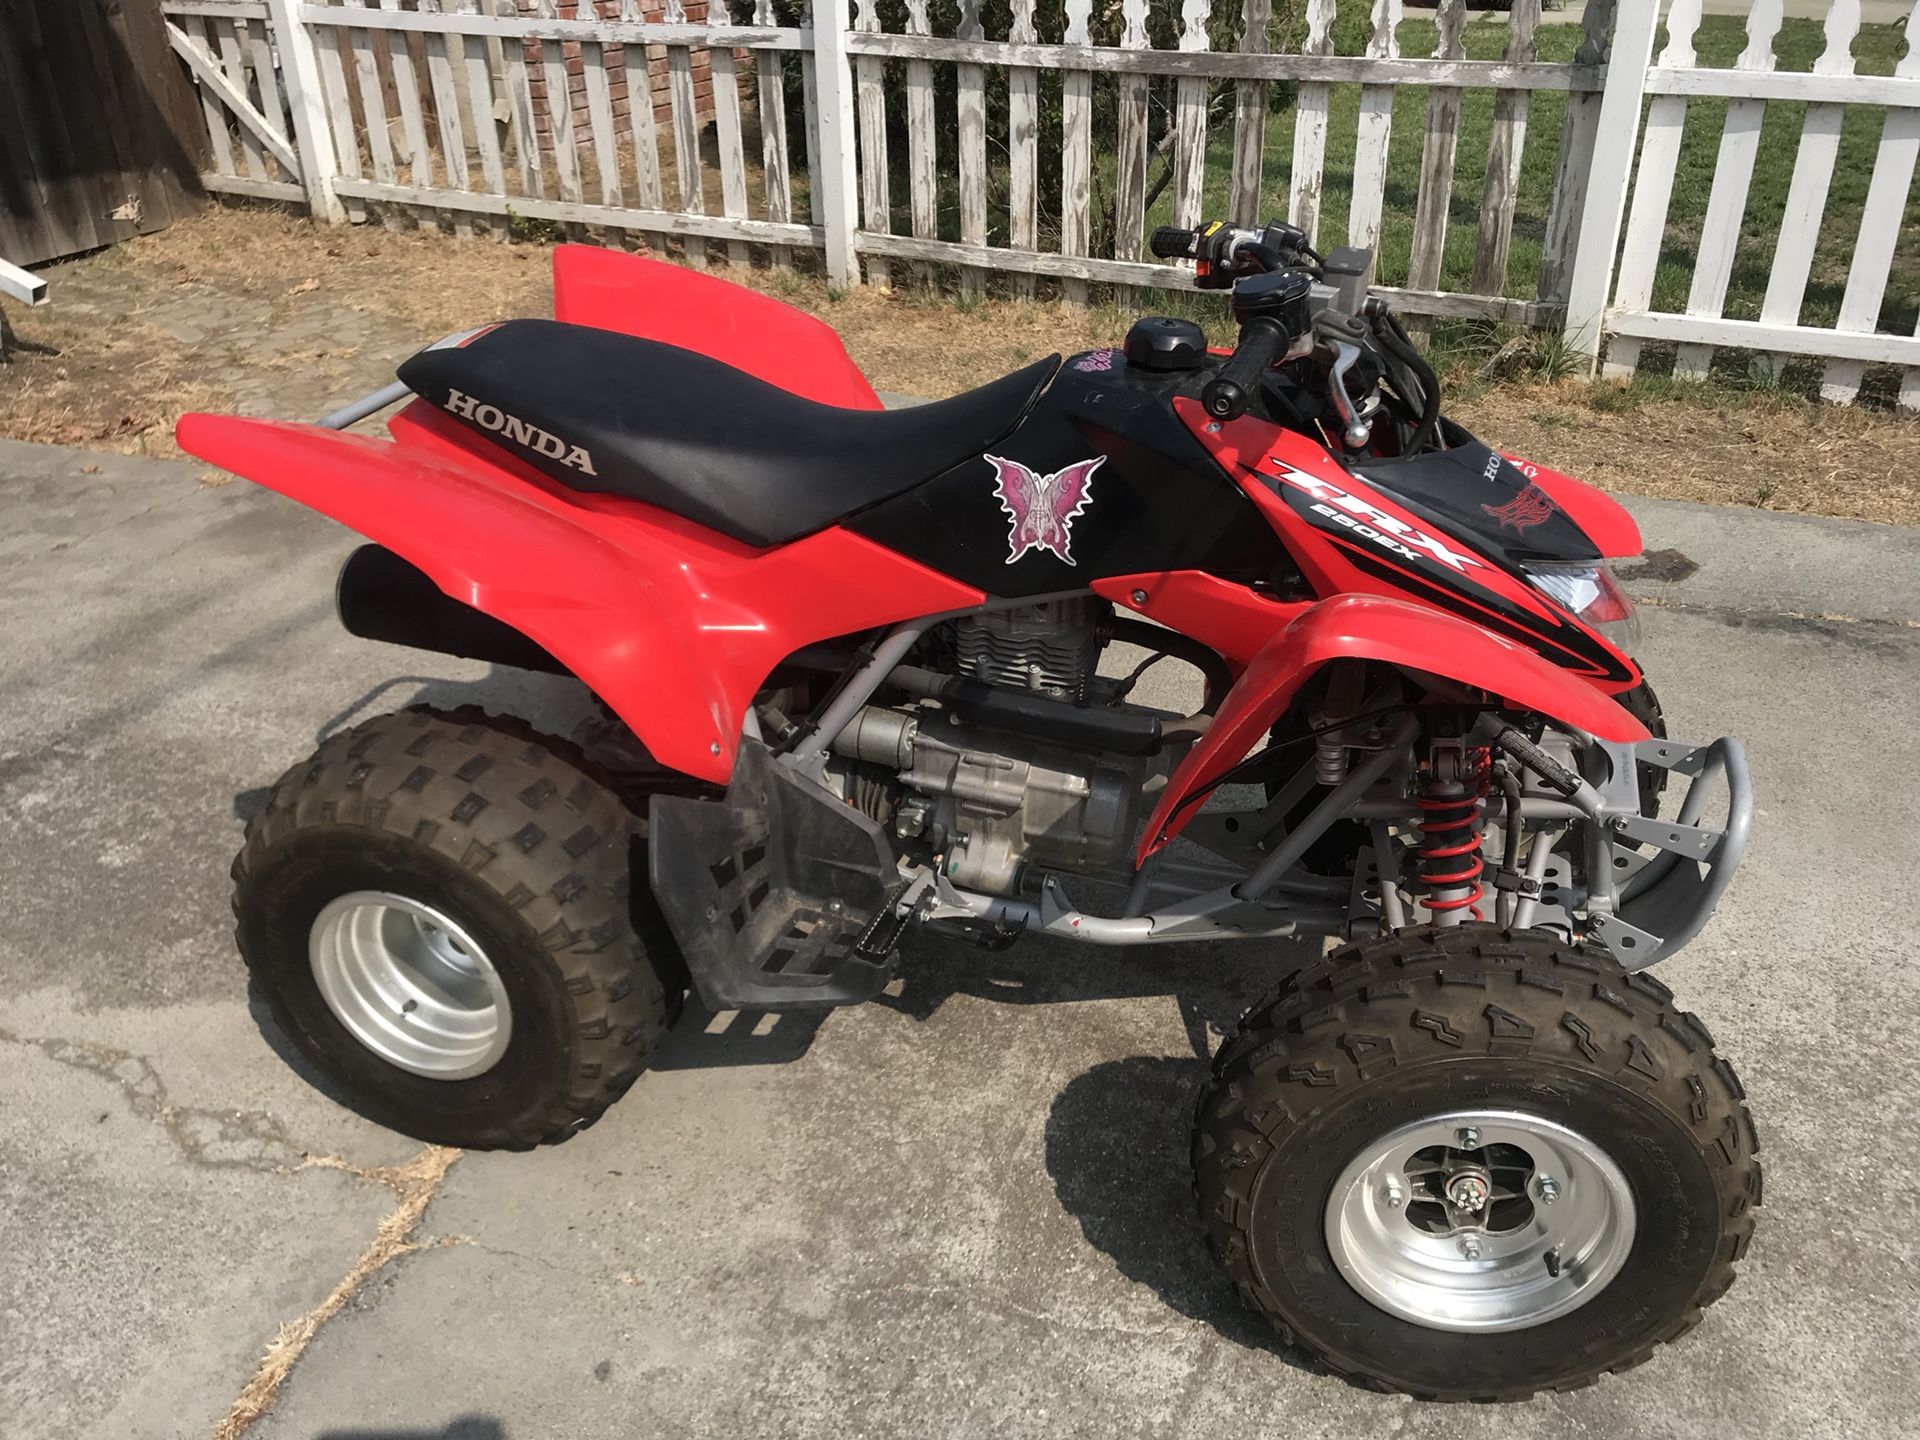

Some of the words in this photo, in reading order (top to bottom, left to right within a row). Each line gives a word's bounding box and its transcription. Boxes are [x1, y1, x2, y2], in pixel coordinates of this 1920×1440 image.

[443, 388, 598, 476] HONDA
[1484, 452, 1502, 482] HO
[1271, 457, 1485, 572] TRX
